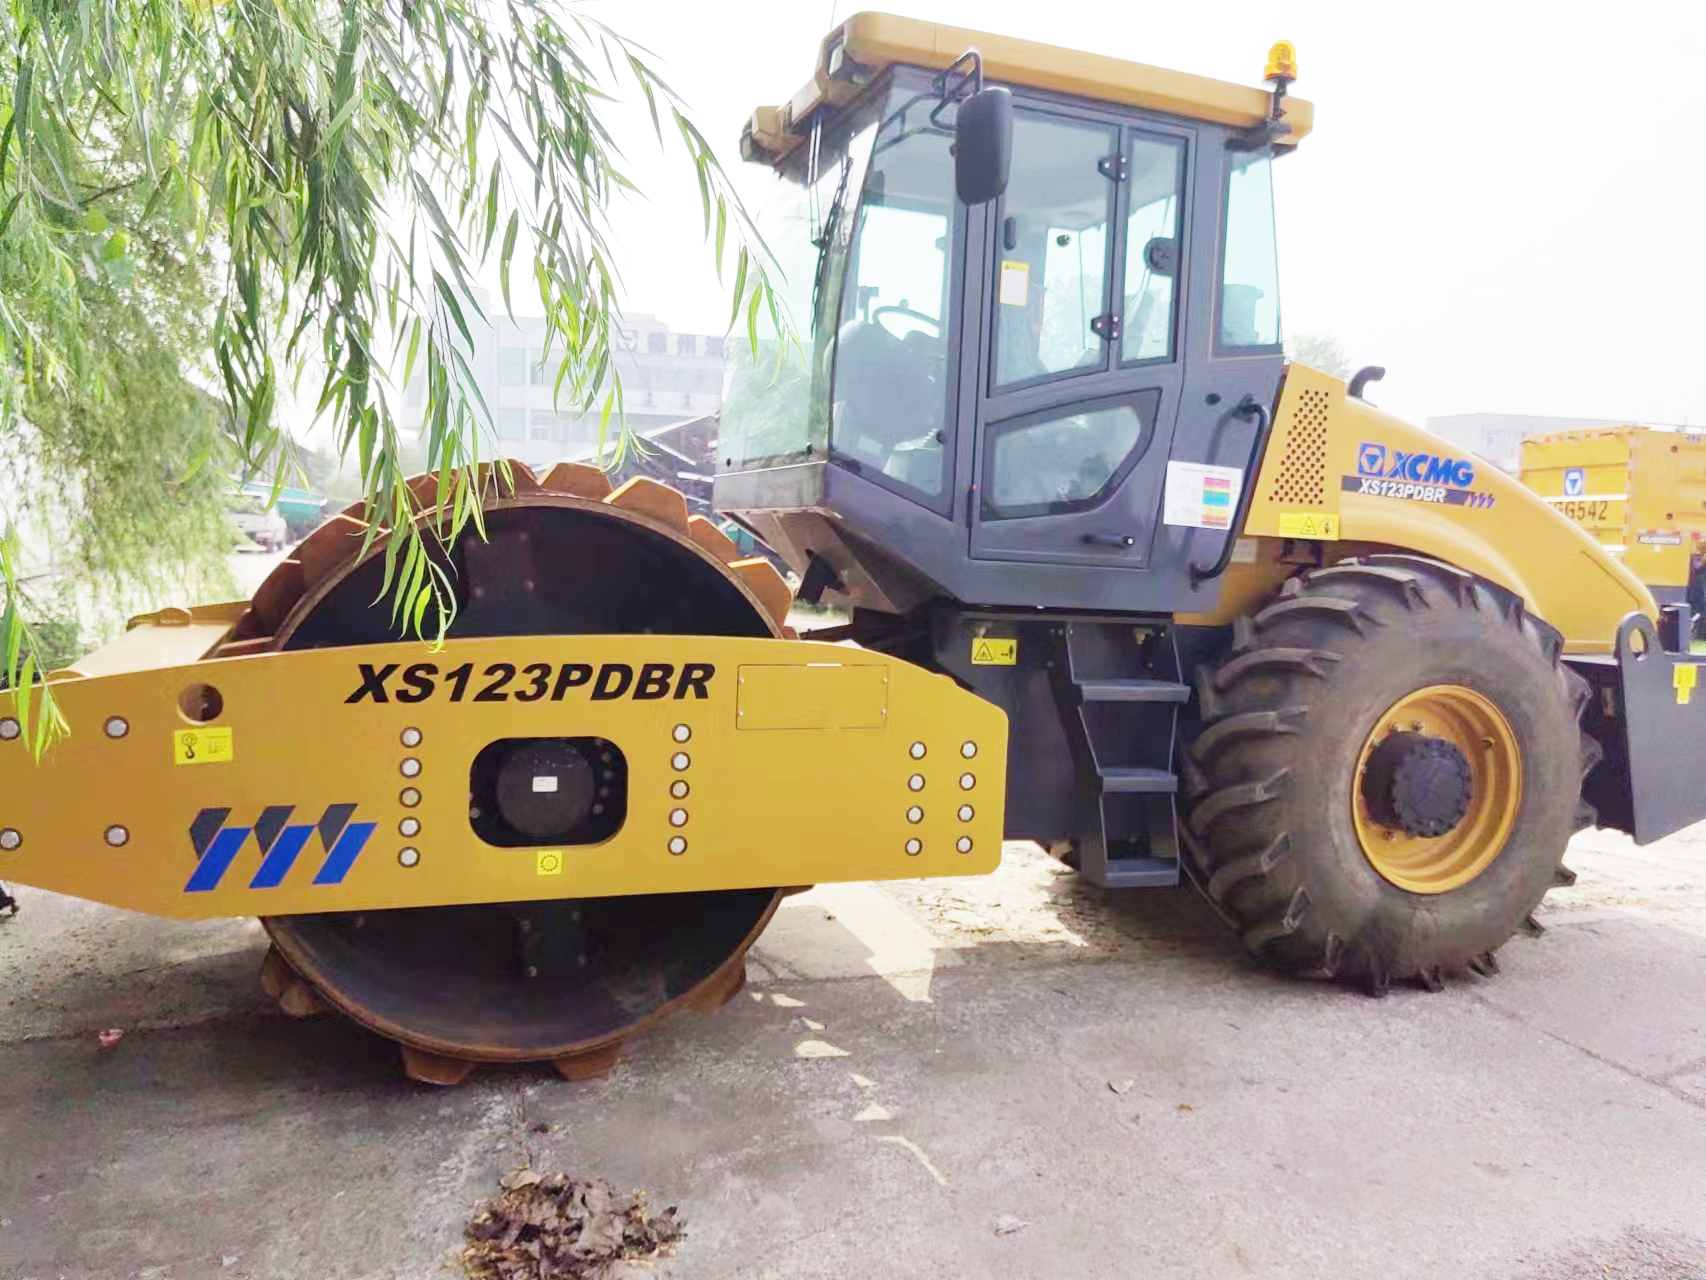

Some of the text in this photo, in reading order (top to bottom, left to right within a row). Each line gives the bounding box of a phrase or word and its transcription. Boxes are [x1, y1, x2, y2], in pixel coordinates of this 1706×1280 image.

[1384, 451, 1474, 487] XCMG
[1358, 478, 1446, 503] XS123PDBR
[344, 662, 716, 704] XS123PDBR
